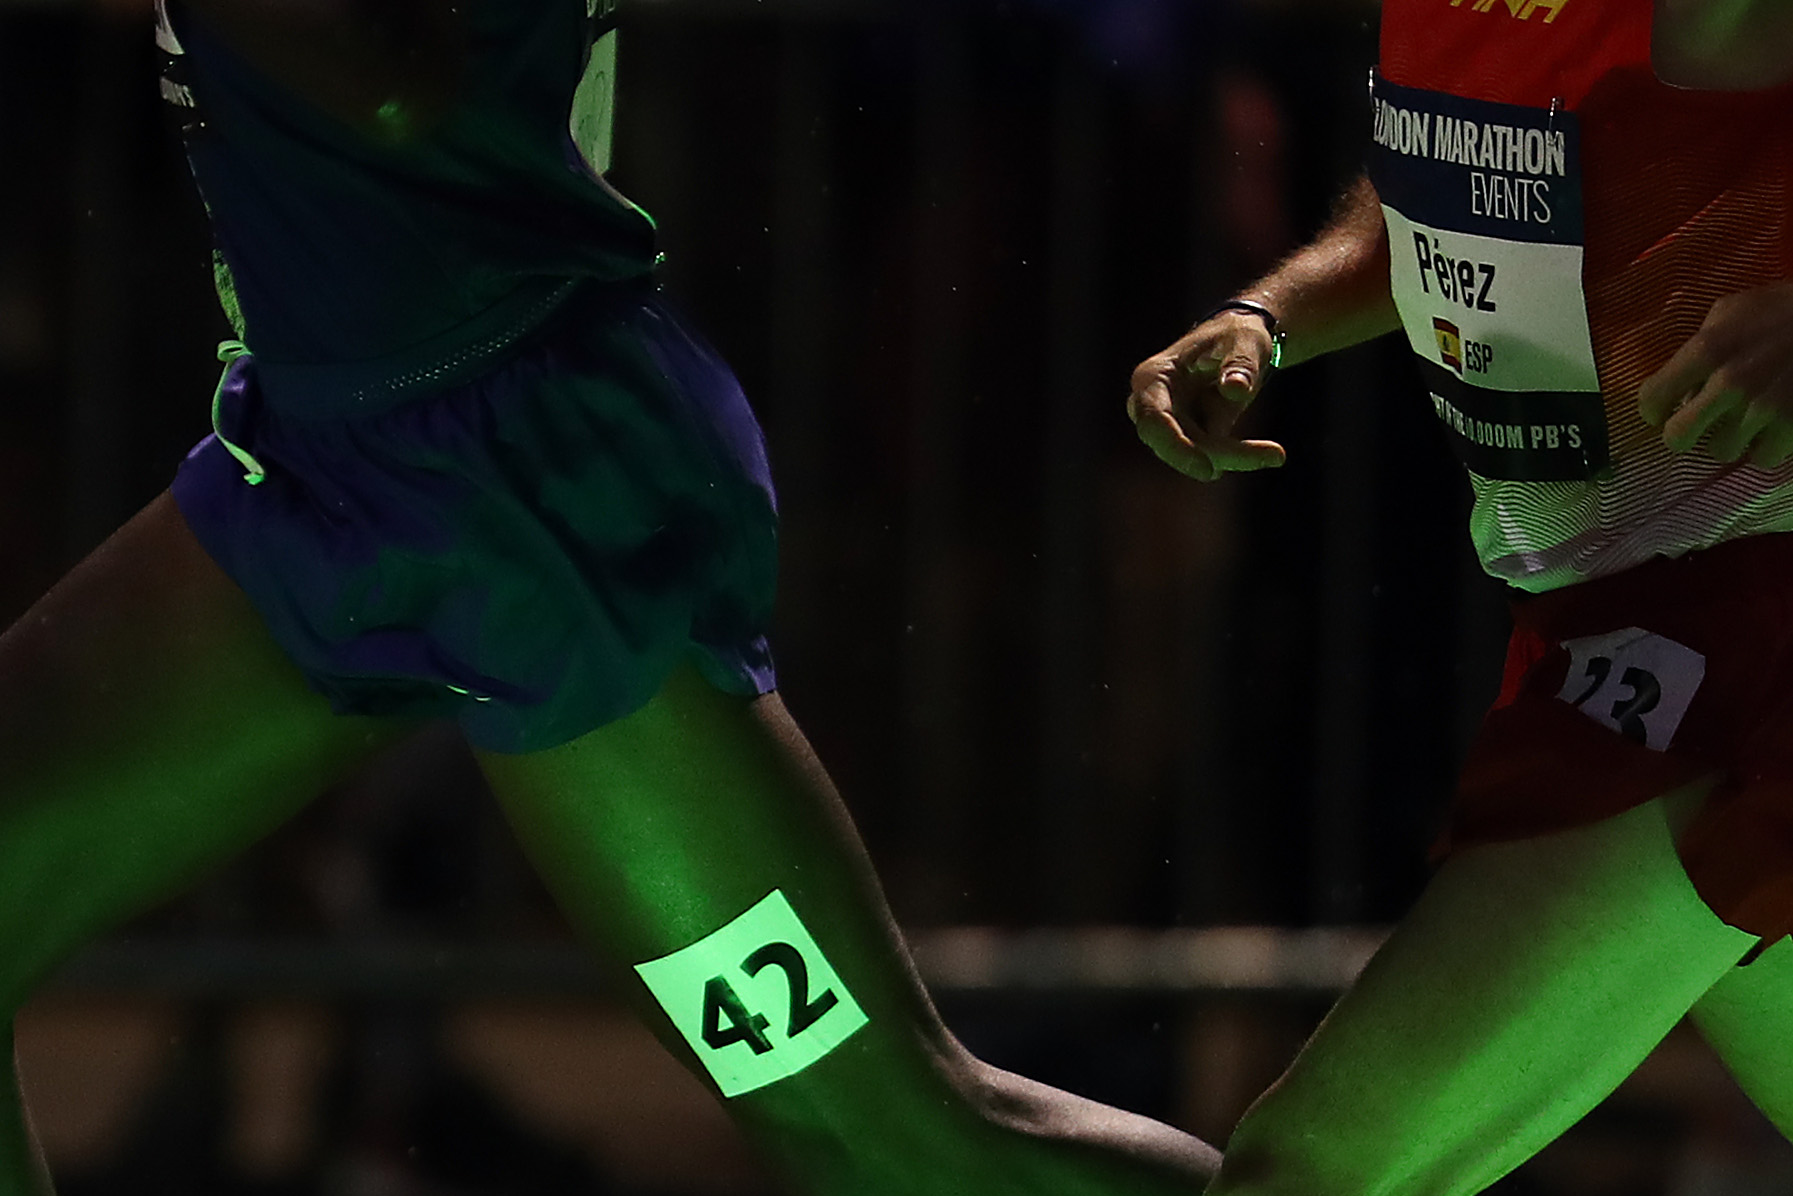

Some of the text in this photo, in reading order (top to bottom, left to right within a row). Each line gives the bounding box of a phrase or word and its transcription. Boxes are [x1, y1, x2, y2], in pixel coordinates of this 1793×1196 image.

[1372, 96, 1566, 177] LONDON MARATHON
[1470, 171, 1552, 224] EVENTS
[1413, 231, 1496, 312] Pérez
[1464, 340, 1493, 374] ESP
[1530, 423, 1583, 450] PB'S
[702, 942, 839, 1055] 42
